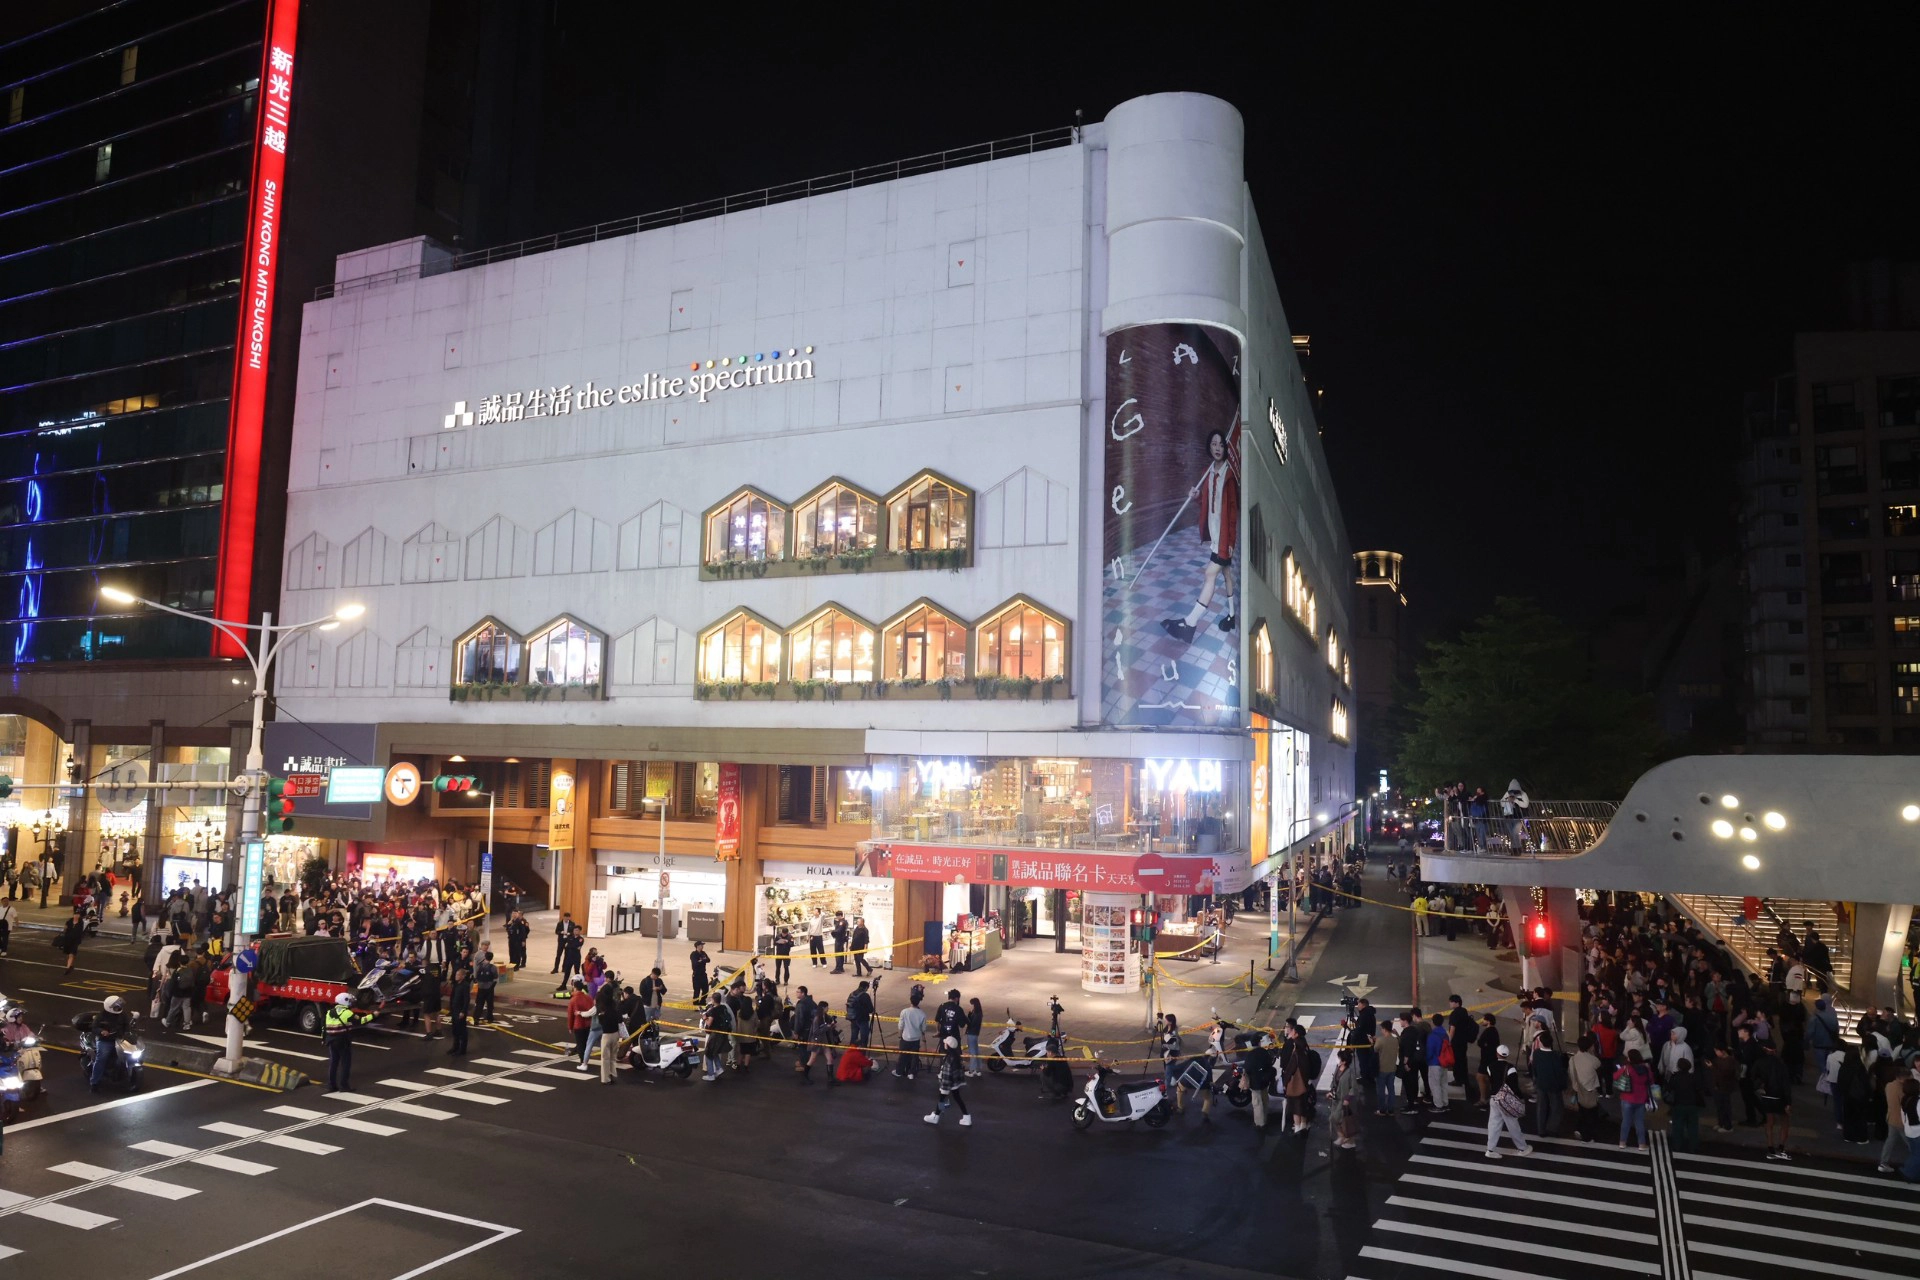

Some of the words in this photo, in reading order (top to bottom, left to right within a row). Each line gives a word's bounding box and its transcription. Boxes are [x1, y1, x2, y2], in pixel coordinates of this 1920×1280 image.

[264, 46, 293, 154] 新光三越
[262, 179, 276, 219] SHIN
[258, 220, 273, 266] KONG
[249, 268, 269, 369] MITSUKOSHI
[479, 385, 572, 424] 誠品生活
[576, 381, 612, 410] the
[618, 373, 683, 404] eslite
[689, 359, 814, 403] spectrum
[1145, 759, 1222, 792] YABI
[806, 866, 833, 876] HOLA
[895, 853, 971, 868] 在誠品，時光正好
[1020, 860, 1107, 883] 誠品聯名卡
